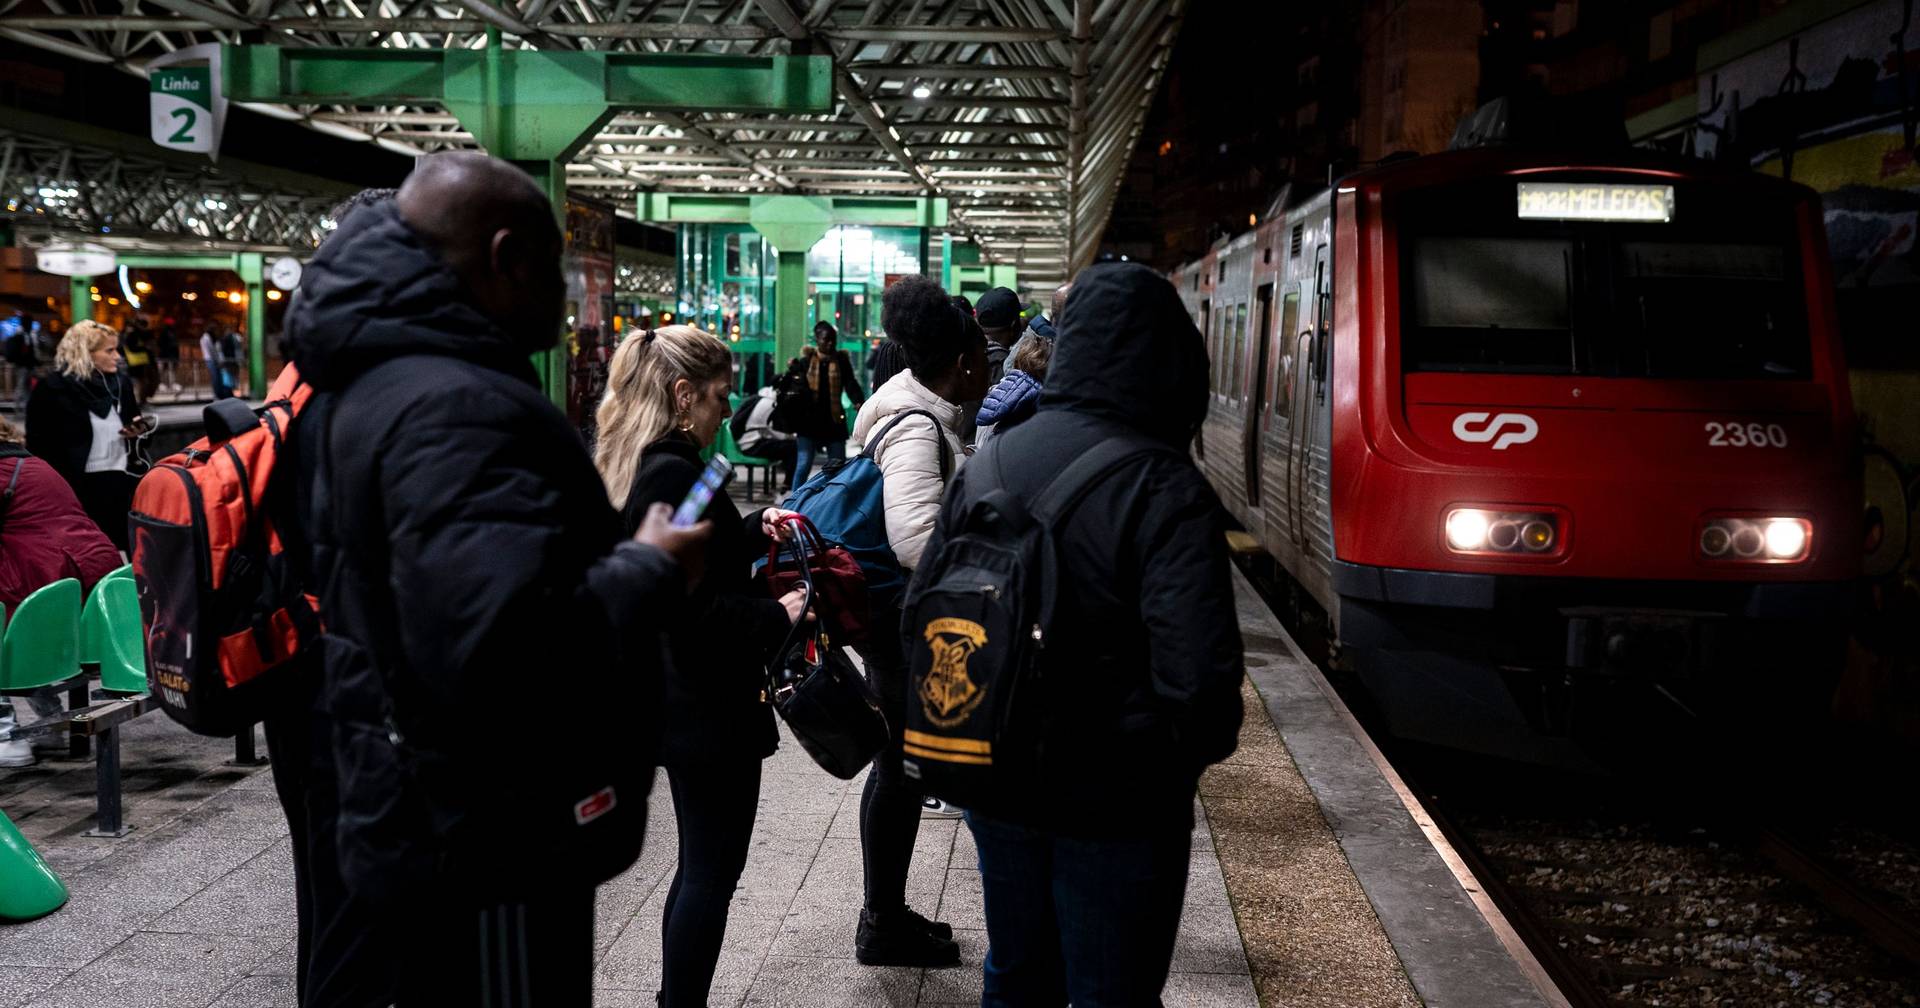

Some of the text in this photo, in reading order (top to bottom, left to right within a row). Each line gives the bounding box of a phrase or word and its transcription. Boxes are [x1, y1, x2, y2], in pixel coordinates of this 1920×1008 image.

[161, 76, 200, 91] Linha
[168, 107, 197, 143] 2
[1704, 421, 1788, 448] 2360
